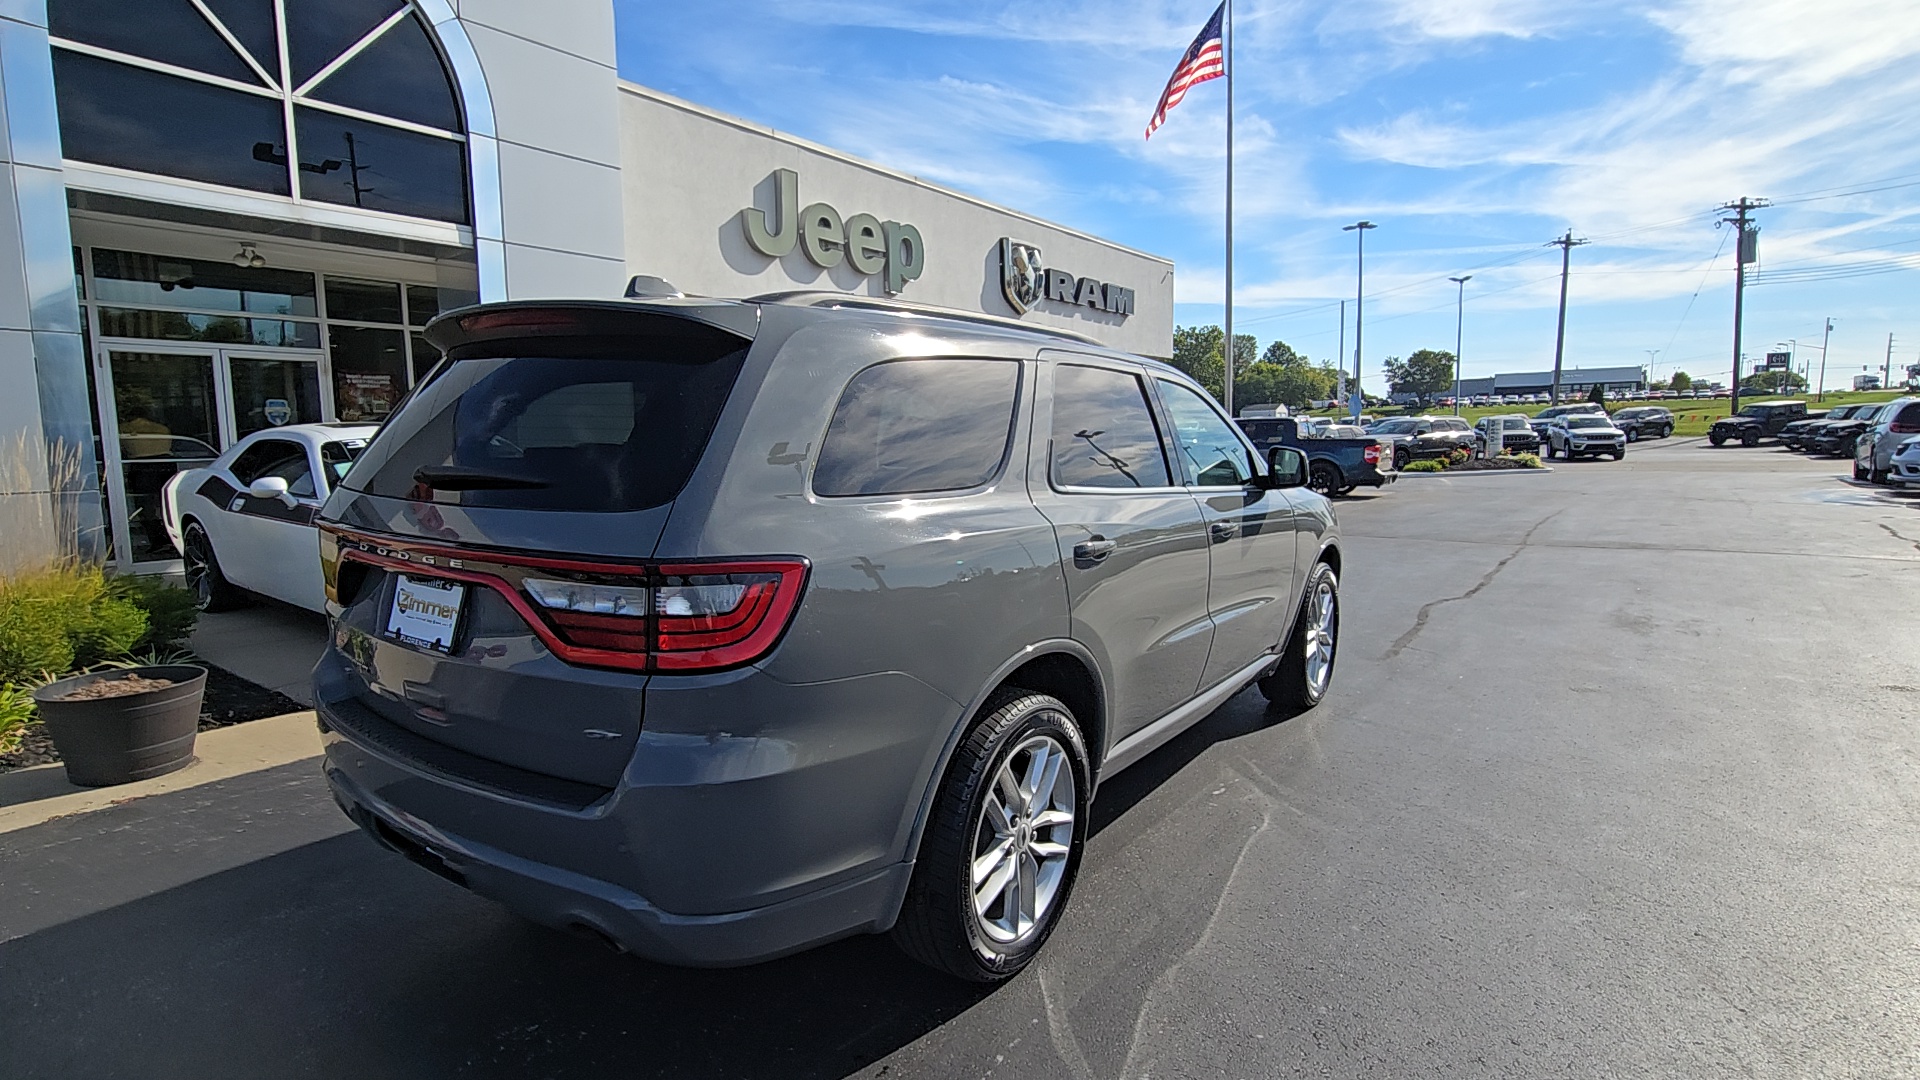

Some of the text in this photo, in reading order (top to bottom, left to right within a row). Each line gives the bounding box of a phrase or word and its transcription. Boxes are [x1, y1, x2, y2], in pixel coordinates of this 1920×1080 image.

[742, 168, 924, 294] Jeep
[1044, 268, 1135, 315] RAM
[360, 543, 463, 569] DODGE
[401, 590, 458, 620] Zimmer
[400, 635, 432, 649] FLORENCE
[1047, 713, 1076, 740] KUMHO
